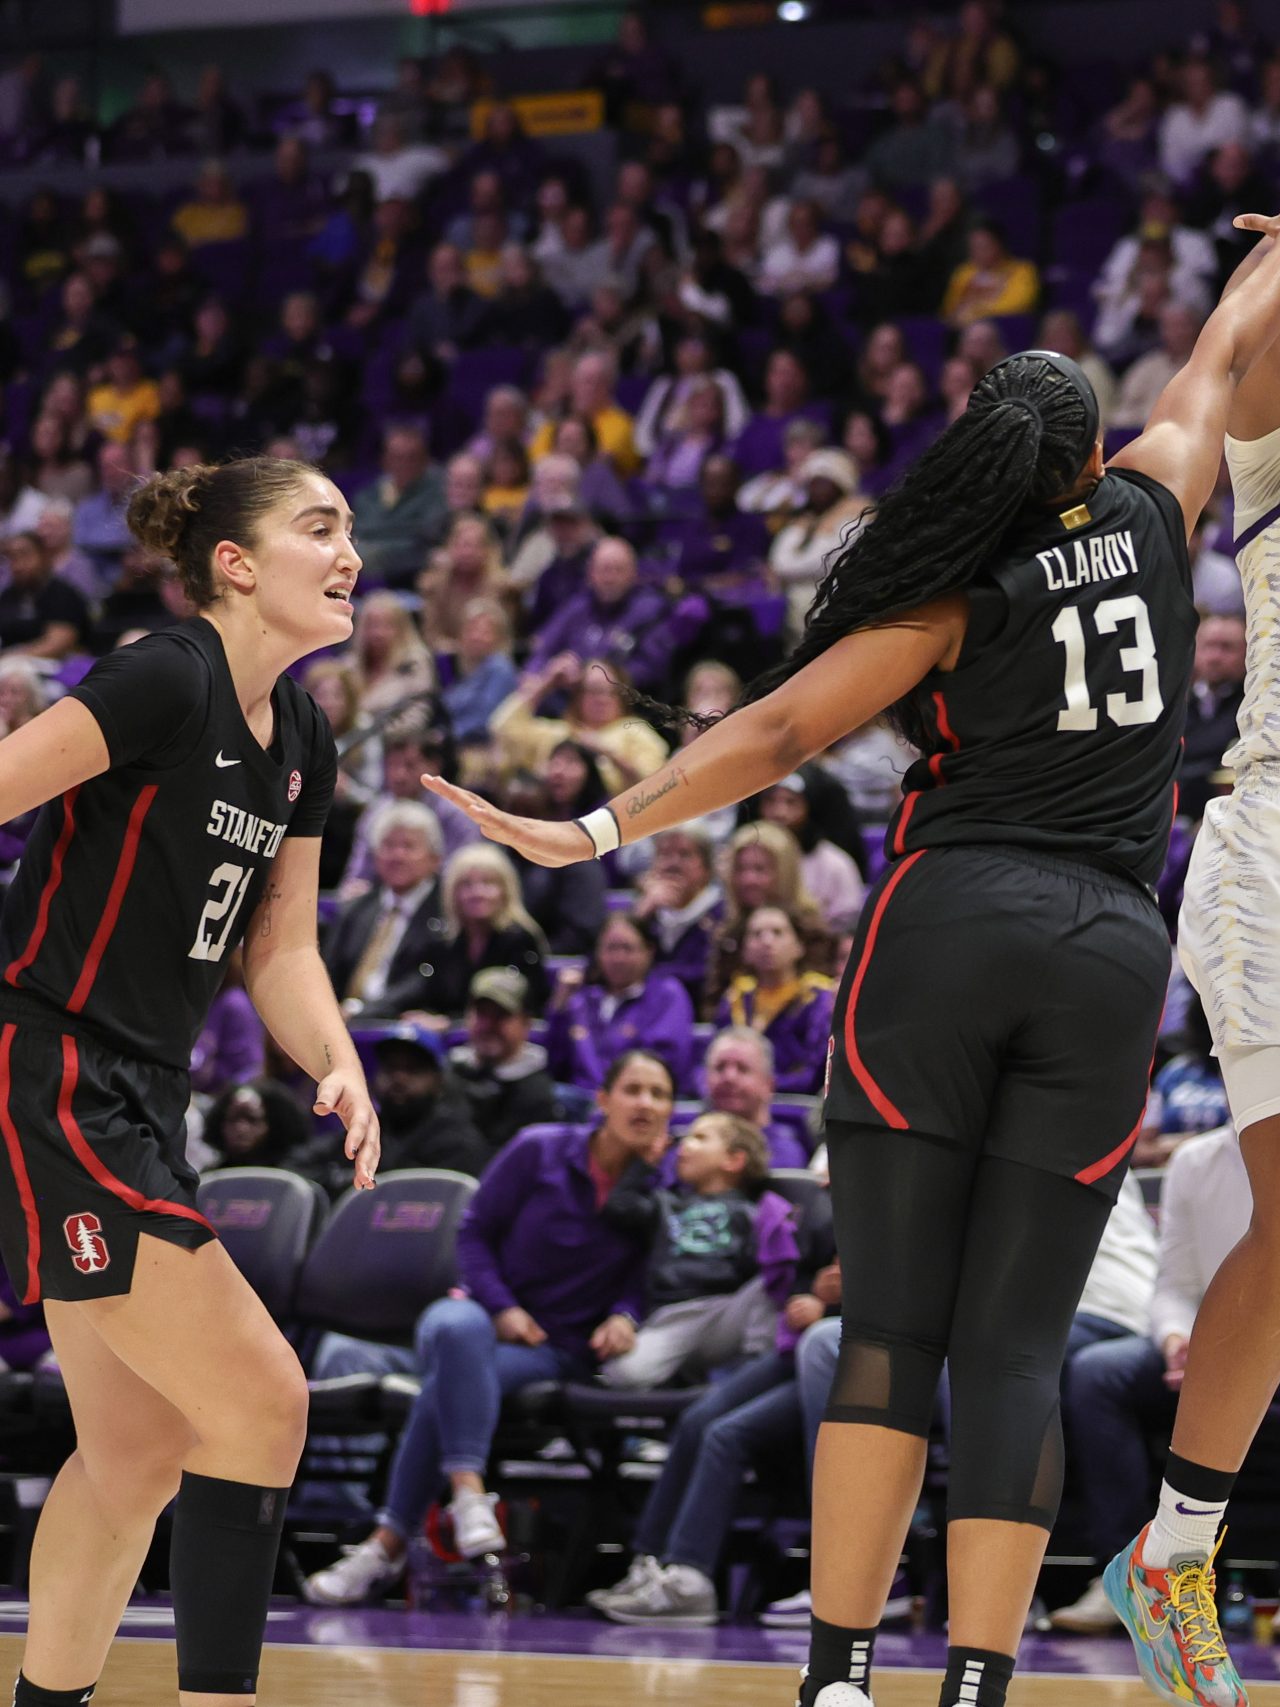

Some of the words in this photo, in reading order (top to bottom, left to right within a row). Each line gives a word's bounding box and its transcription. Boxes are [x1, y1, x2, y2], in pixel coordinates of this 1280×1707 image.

[1051, 594, 1165, 732] 13
[187, 861, 255, 963] 21
[371, 1201, 444, 1231] LSU
